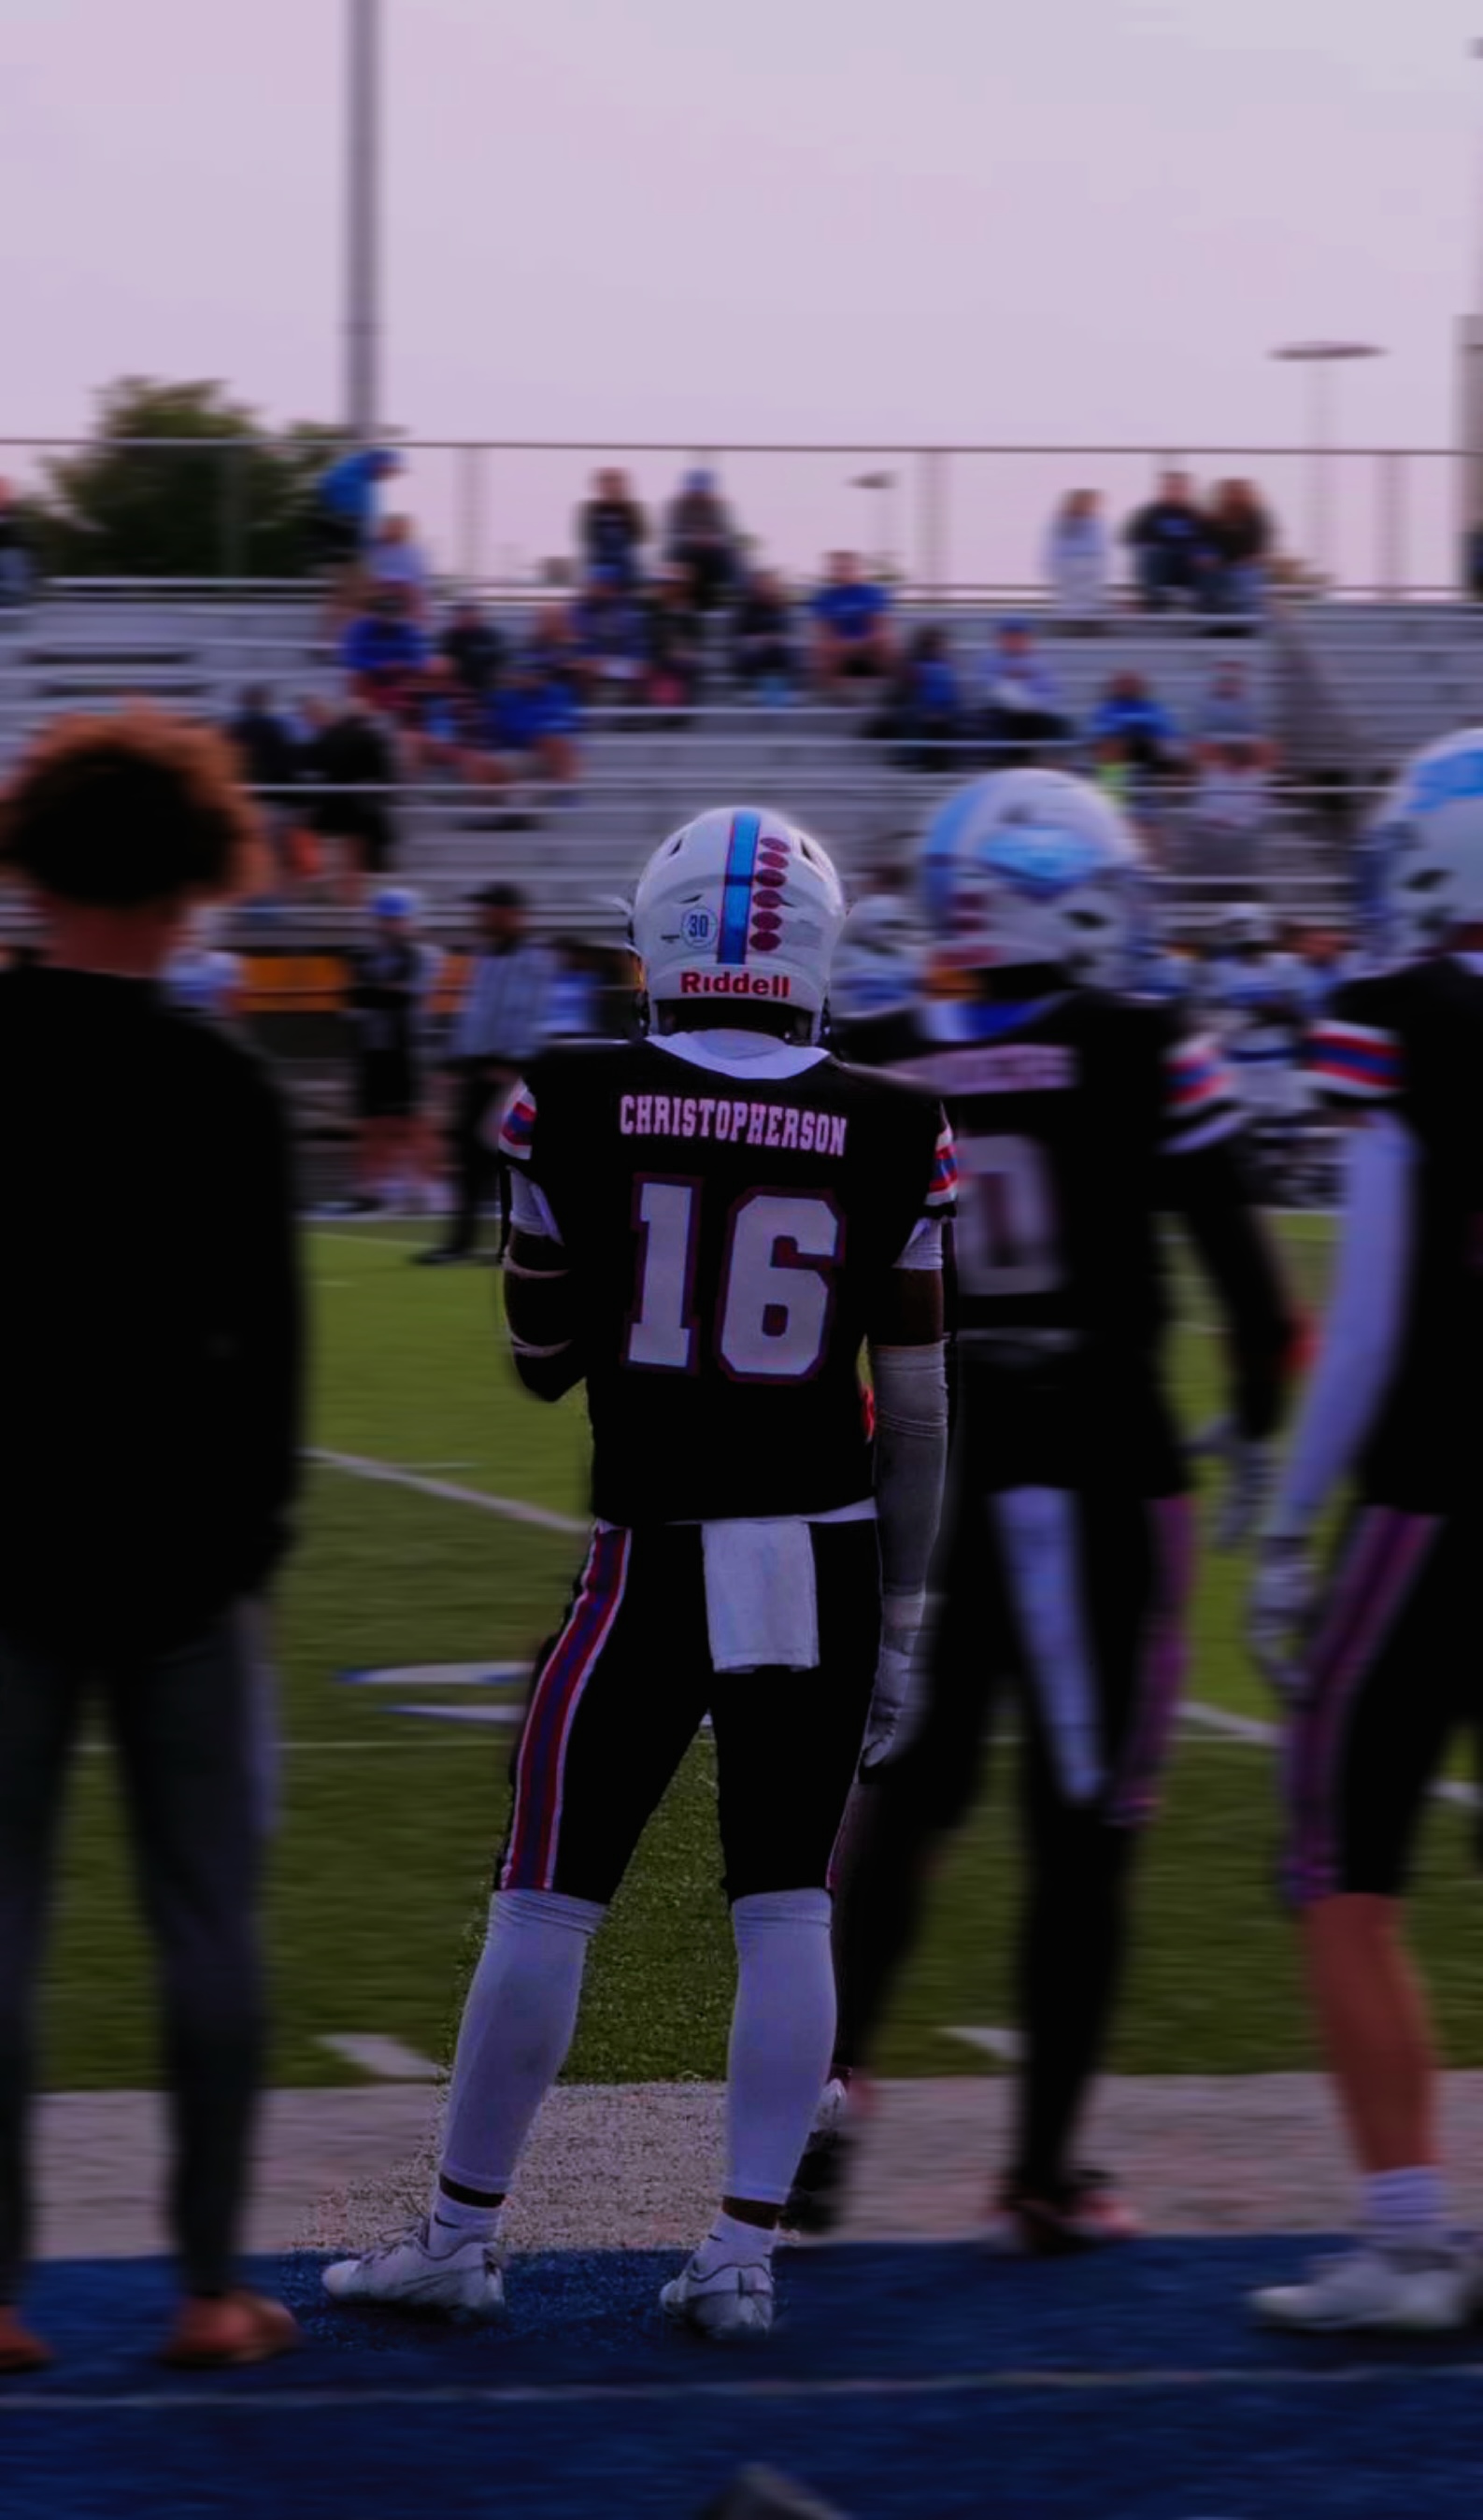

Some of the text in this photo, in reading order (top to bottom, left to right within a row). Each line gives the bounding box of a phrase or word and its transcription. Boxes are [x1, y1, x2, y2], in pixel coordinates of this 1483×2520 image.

[689, 915, 708, 937] 30
[680, 972, 790, 998] Riddell
[619, 1094, 848, 1157] CHRISTOPHERSON
[620, 1174, 845, 1383] 16
